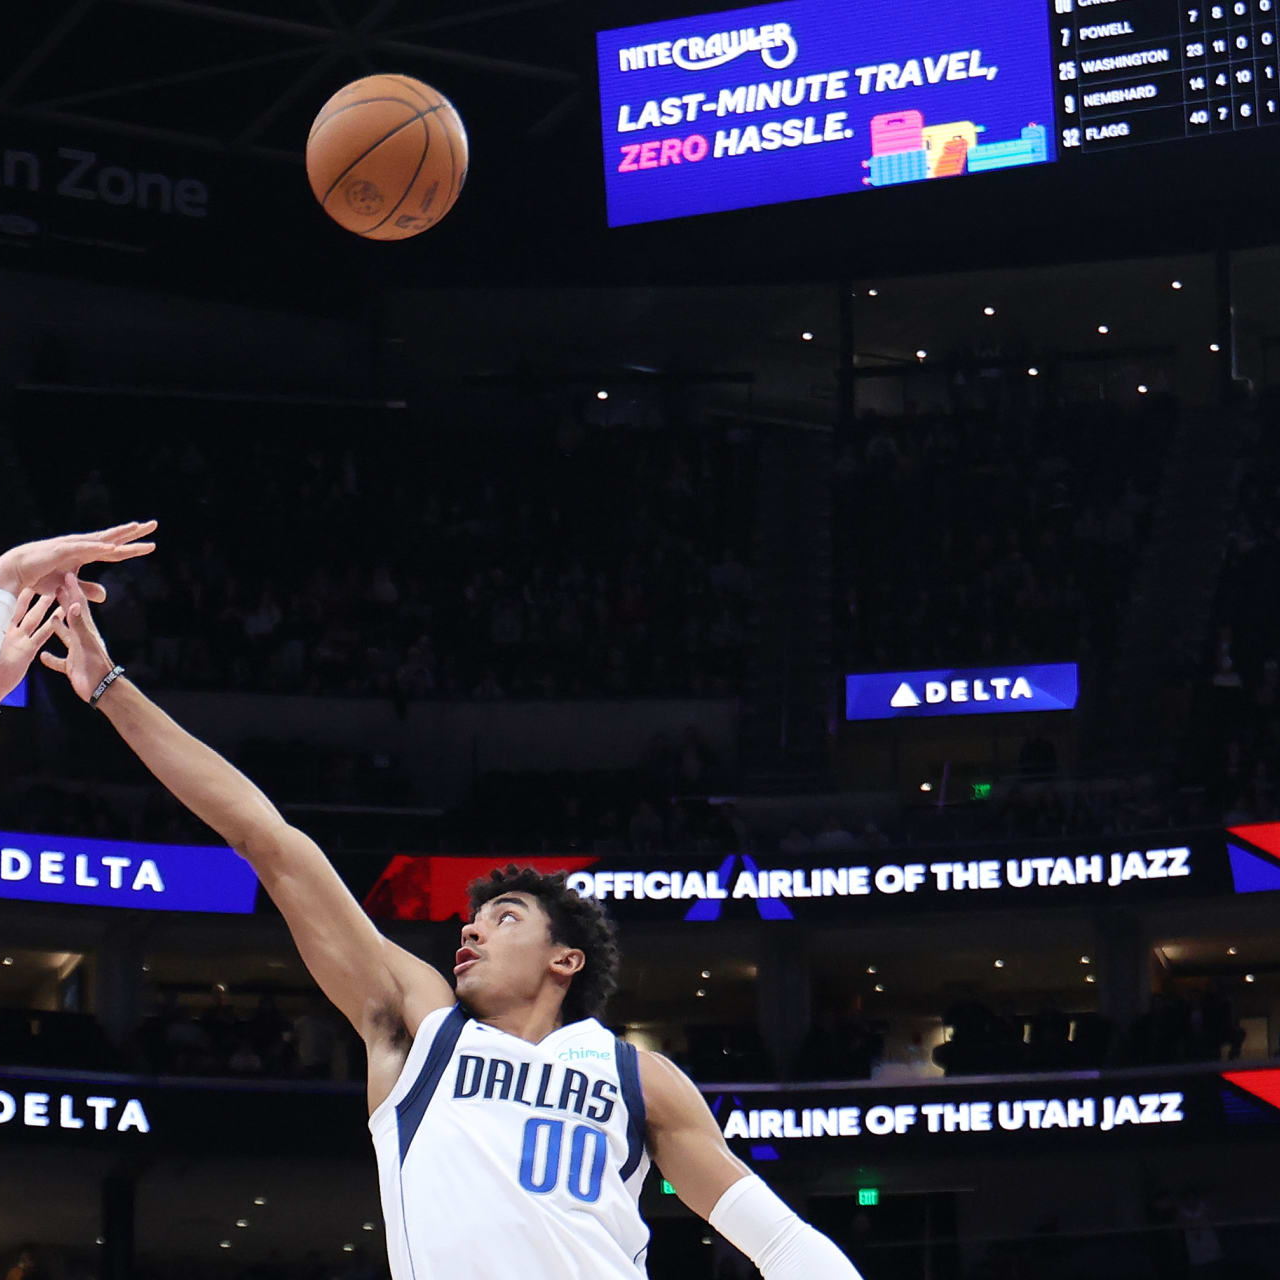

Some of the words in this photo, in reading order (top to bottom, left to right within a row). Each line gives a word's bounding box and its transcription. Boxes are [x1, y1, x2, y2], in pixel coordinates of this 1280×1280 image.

[1079, 21, 1134, 41] POWELL
[1080, 48, 1169, 74] WASHINGTON
[617, 69, 854, 137] LAST-MINUTE
[854, 49, 999, 95] TRAVEL,
[1083, 84, 1157, 108] NEMBHARD
[618, 134, 708, 172] ZERO
[713, 111, 854, 159] HASSLE.
[1085, 122, 1130, 141] FLAGG
[57, 147, 207, 219] Zone
[925, 676, 1033, 704] DELTA
[0, 848, 165, 893] DELTA
[567, 870, 726, 902] OFFICIAL
[732, 866, 871, 899] AIRLINE
[874, 864, 926, 894] OF
[930, 860, 1002, 891] THE
[1006, 854, 1103, 888] UTAH
[1107, 847, 1190, 887] JAZZ
[558, 1047, 611, 1061] chime
[452, 1054, 619, 1123] DALLAS
[723, 1105, 861, 1140] AIRLINE
[865, 1105, 917, 1135] OF
[920, 1102, 993, 1133] THE
[997, 1098, 1095, 1131] UTAH
[1100, 1092, 1184, 1131] JAZZ
[518, 1117, 608, 1203] 00
